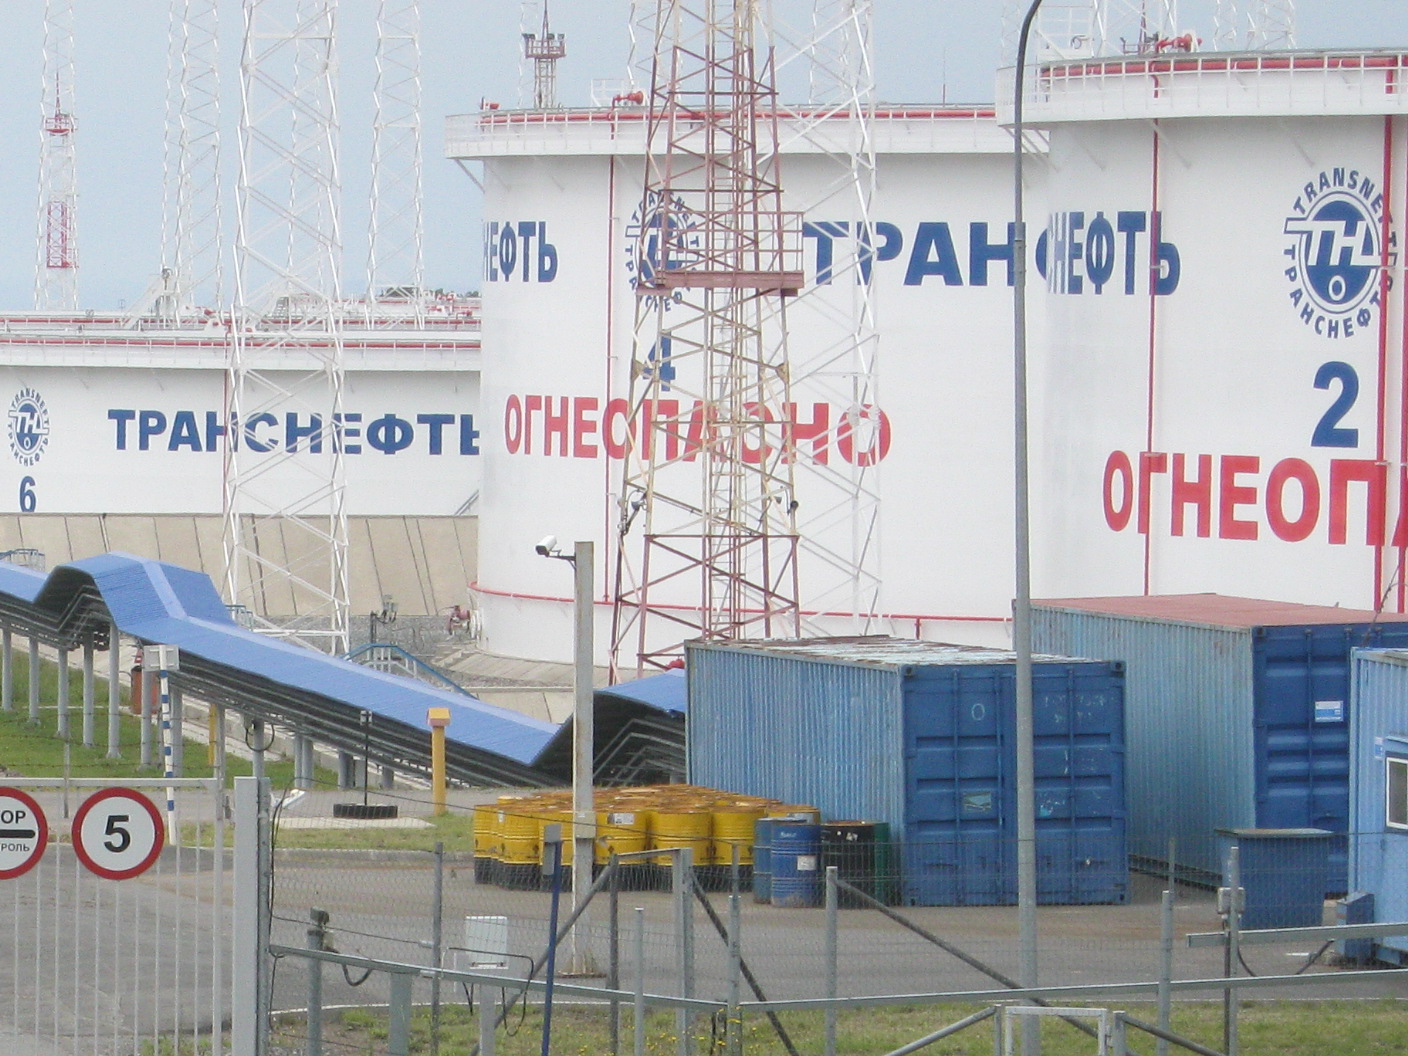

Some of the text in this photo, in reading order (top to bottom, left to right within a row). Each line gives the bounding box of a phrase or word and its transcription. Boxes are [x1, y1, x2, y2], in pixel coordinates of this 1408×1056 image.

[643, 330, 676, 392] 4
[504, 394, 891, 467] ОГНЕОПАСНО
[1311, 360, 1359, 448] 2
[19, 476, 37, 512] 6
[103, 814, 131, 853] 5
